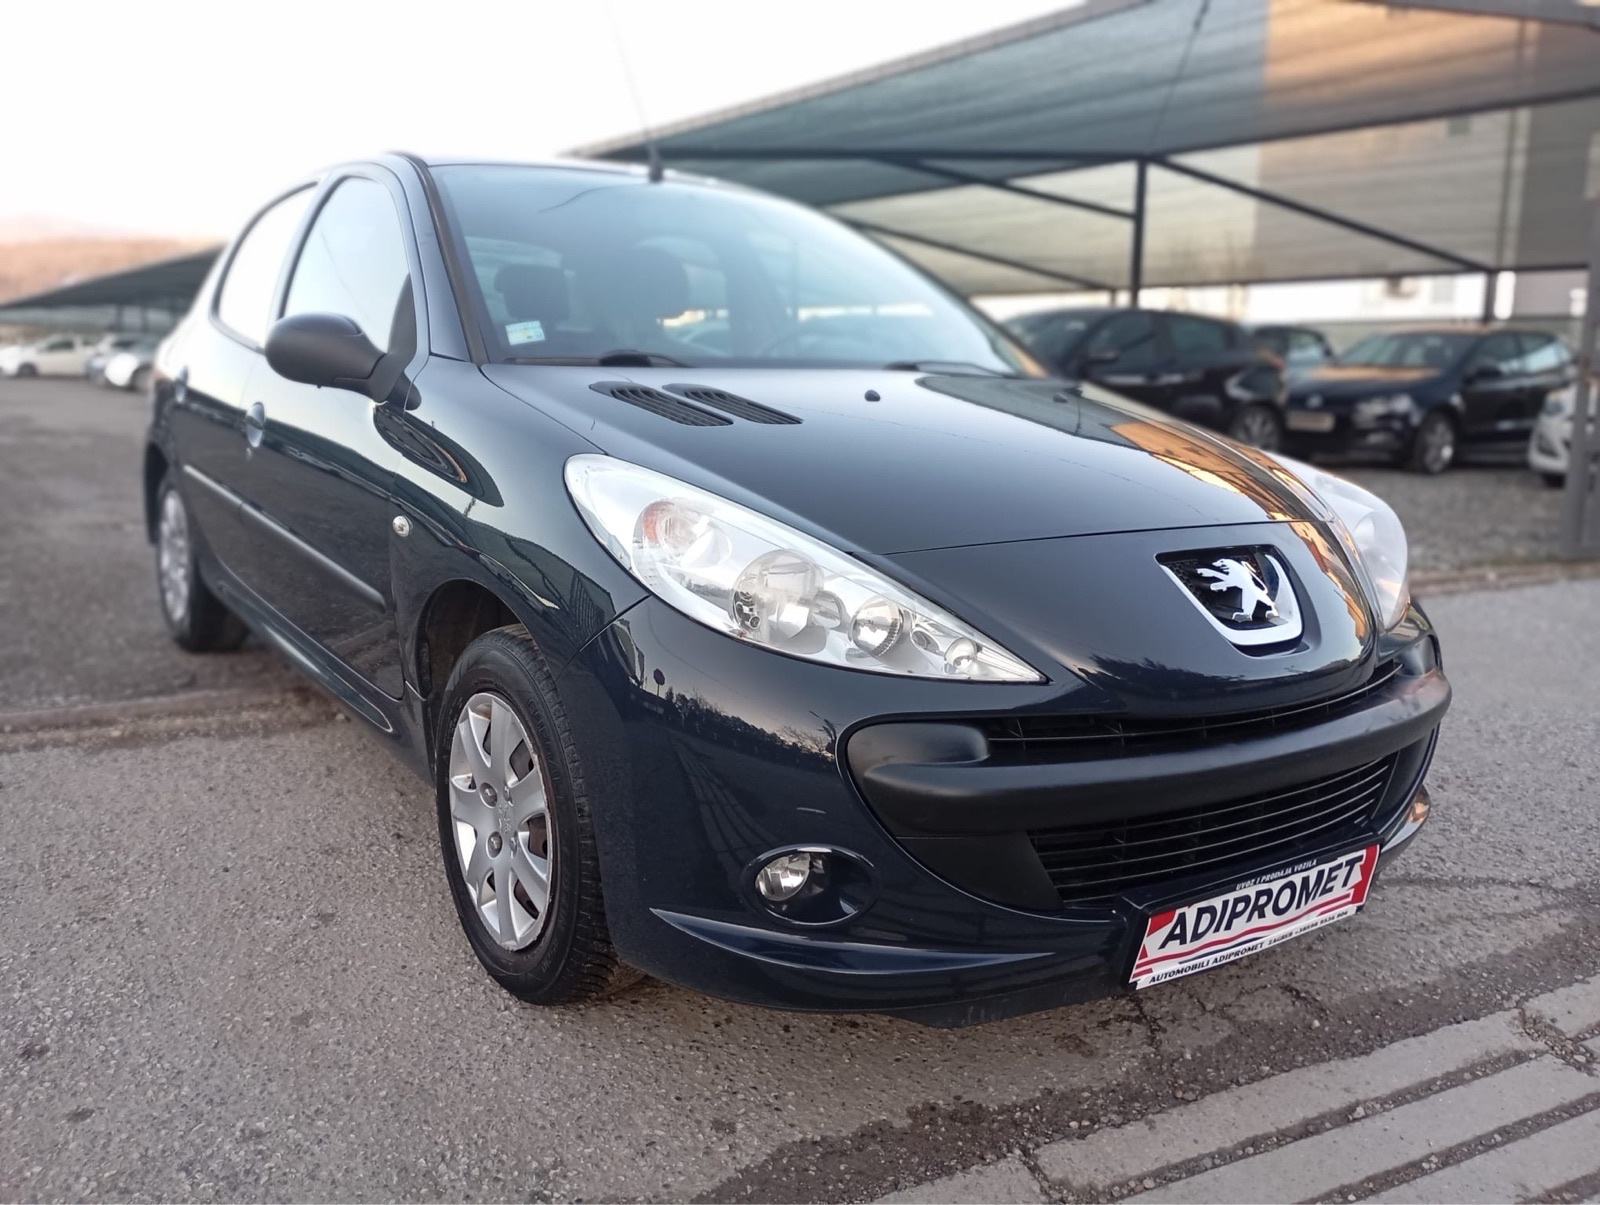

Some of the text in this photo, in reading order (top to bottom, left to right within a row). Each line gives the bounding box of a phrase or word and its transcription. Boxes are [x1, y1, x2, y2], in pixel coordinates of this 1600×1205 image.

[1158, 855, 1364, 950] ADIPROMET
[1149, 959, 1210, 984] AUTOMOBILI
[1211, 942, 1265, 966] ADIPROMET
